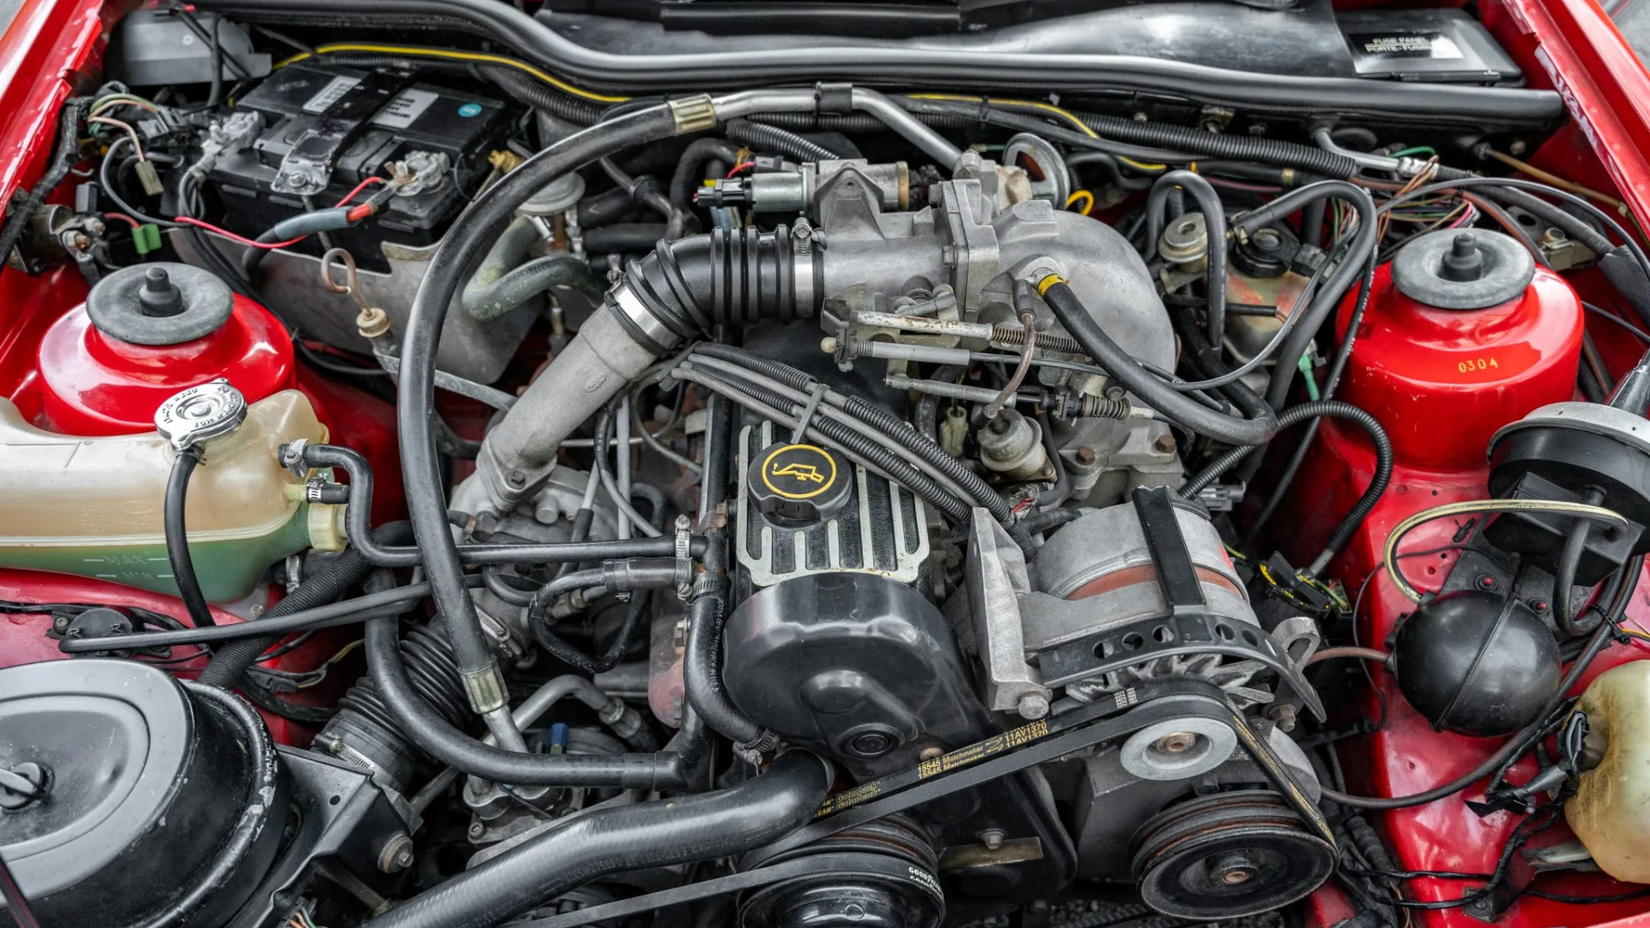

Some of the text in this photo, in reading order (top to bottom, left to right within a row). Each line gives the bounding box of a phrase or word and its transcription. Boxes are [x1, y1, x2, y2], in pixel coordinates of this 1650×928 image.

[1458, 358, 1498, 373] 0304
[916, 721, 1047, 773] 15545 Matchmaker 11AV1370
